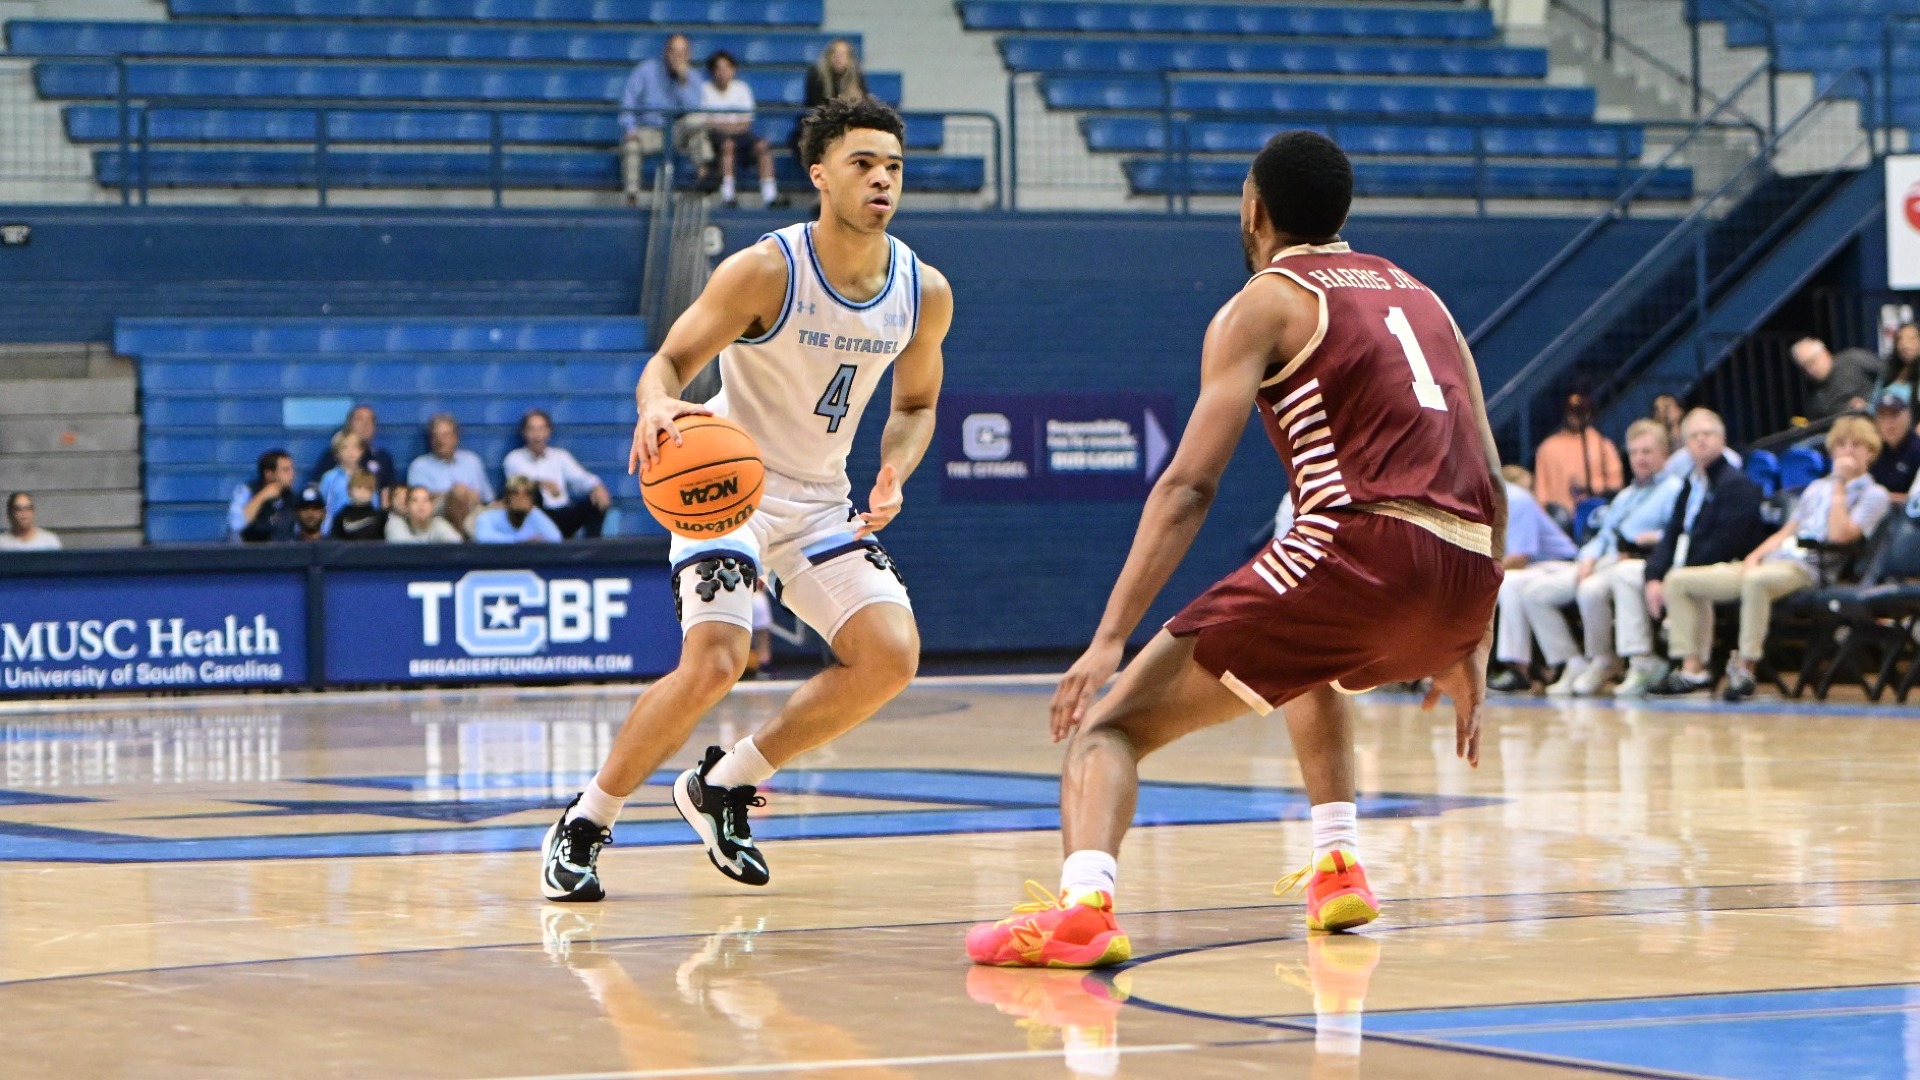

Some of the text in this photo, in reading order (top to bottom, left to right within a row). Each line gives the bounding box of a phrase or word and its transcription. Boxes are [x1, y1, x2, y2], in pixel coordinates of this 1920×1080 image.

[1308, 267, 1425, 291] HARRIS JR.
[798, 329, 899, 354] THE CITADEL
[1384, 306, 1448, 411] 1
[813, 363, 858, 433] 4
[679, 475, 739, 506] NCAA
[674, 503, 754, 532] Wilson
[1, 613, 281, 662] MUSC Health
[5, 659, 282, 689] University of South Carolina
[409, 654, 633, 677] BRIGADIERFOUNDATION.COM
